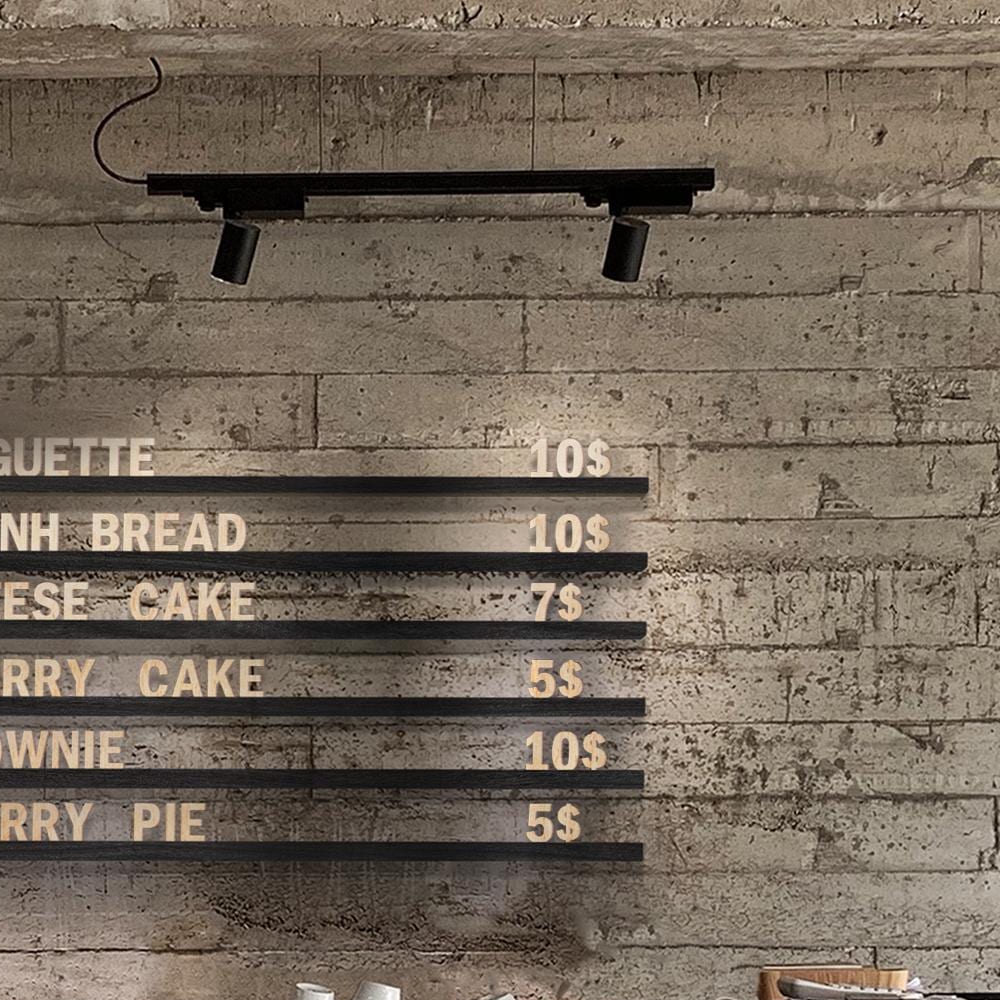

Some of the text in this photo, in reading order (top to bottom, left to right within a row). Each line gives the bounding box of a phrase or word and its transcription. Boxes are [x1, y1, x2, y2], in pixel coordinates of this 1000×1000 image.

[530, 438, 611, 478] 10$
[92, 513, 247, 552] BREAD
[529, 514, 610, 553] 10$
[130, 582, 255, 621] CAKE
[530, 582, 584, 621] 7$
[139, 658, 265, 697] CAKE
[528, 659, 584, 698] 5$
[525, 731, 607, 770] 10$
[133, 803, 206, 841] PIE
[526, 803, 581, 842] 5$
